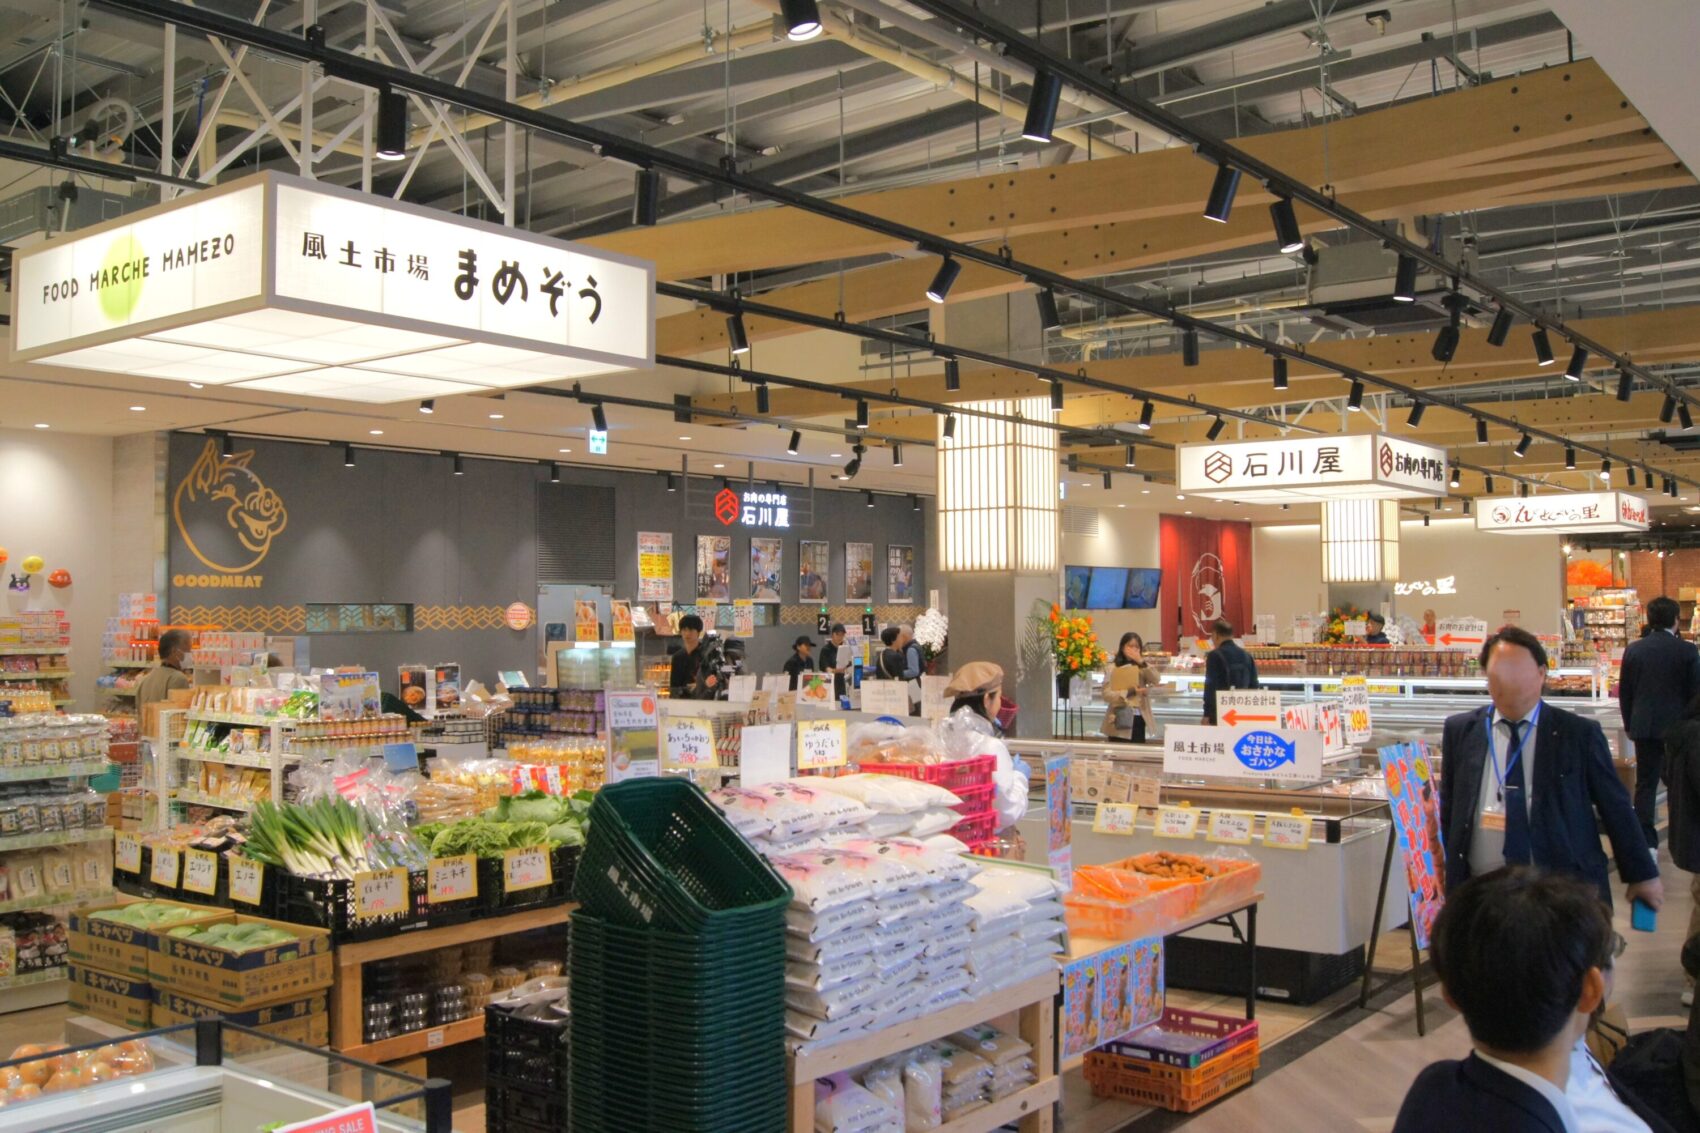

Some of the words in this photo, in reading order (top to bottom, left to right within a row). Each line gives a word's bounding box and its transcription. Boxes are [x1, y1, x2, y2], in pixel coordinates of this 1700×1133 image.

[43, 277, 80, 304] FOOD
[90, 254, 151, 290] MARCHE
[163, 233, 236, 273] MAMEZO
[302, 231, 430, 281] 風土市場
[454, 249, 603, 325] まめぞう
[1242, 446, 1344, 477] 石川屋
[1395, 451, 1443, 482] お肉の専門店
[743, 491, 788, 506] お肉の専門店
[741, 506, 790, 527] 石川屋
[172, 574, 263, 588] GOODMEAT
[819, 617, 827, 632] 2
[864, 616, 872, 632] 1
[1220, 695, 1277, 706] お肉のお会計は
[1350, 709, 1368, 732] 399
[1247, 734, 1278, 745] 今日は、
[1173, 741, 1225, 755] 風土市場
[1240, 745, 1286, 758] おさかな
[1249, 758, 1277, 767] ゴハン
[90, 920, 134, 943] キャベツ
[174, 940, 225, 967] キャベツ
[87, 972, 131, 995] キャベツ
[339, 1118, 364, 1133] SALE
